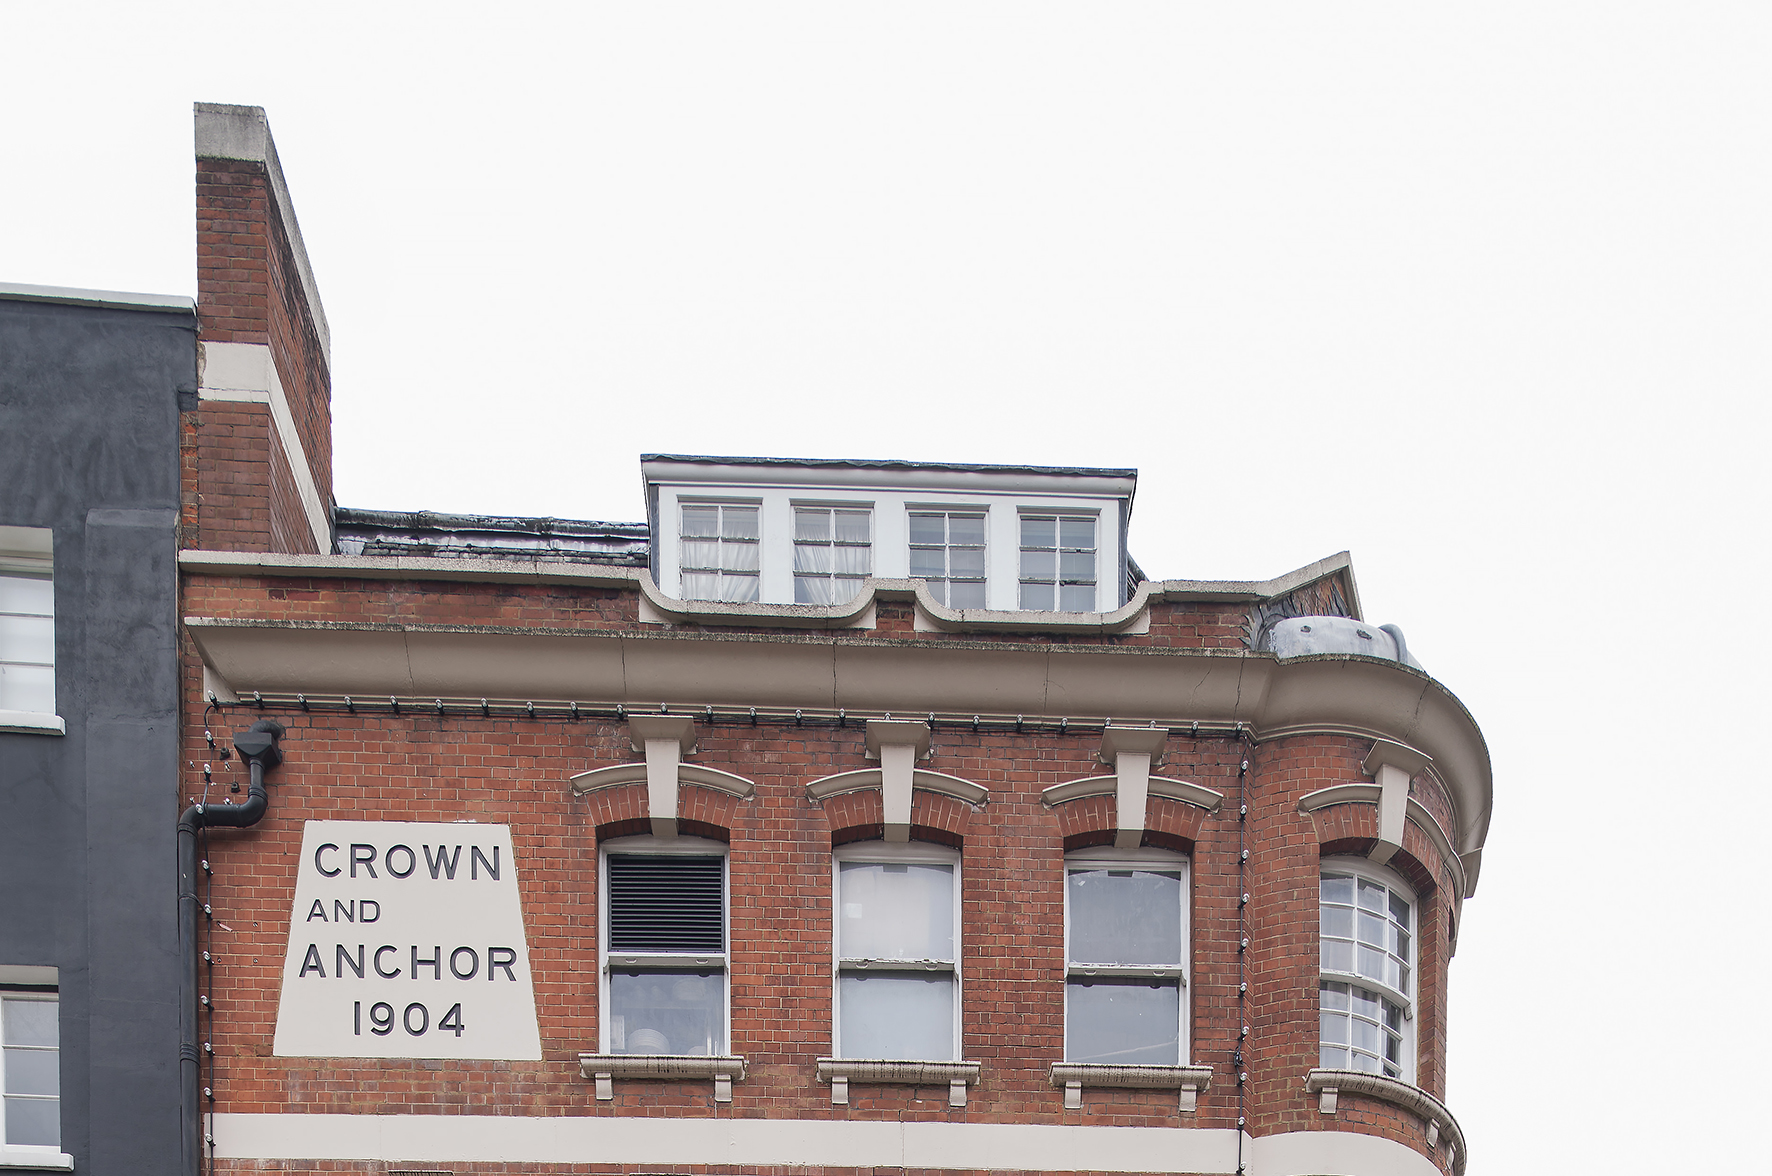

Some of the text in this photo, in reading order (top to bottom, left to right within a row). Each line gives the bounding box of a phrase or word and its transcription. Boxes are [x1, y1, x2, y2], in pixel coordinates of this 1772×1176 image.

[314, 843, 500, 881] CROWN
[306, 898, 381, 923] AND
[298, 943, 518, 982] ANCHOR
[353, 1000, 465, 1037] 1904
